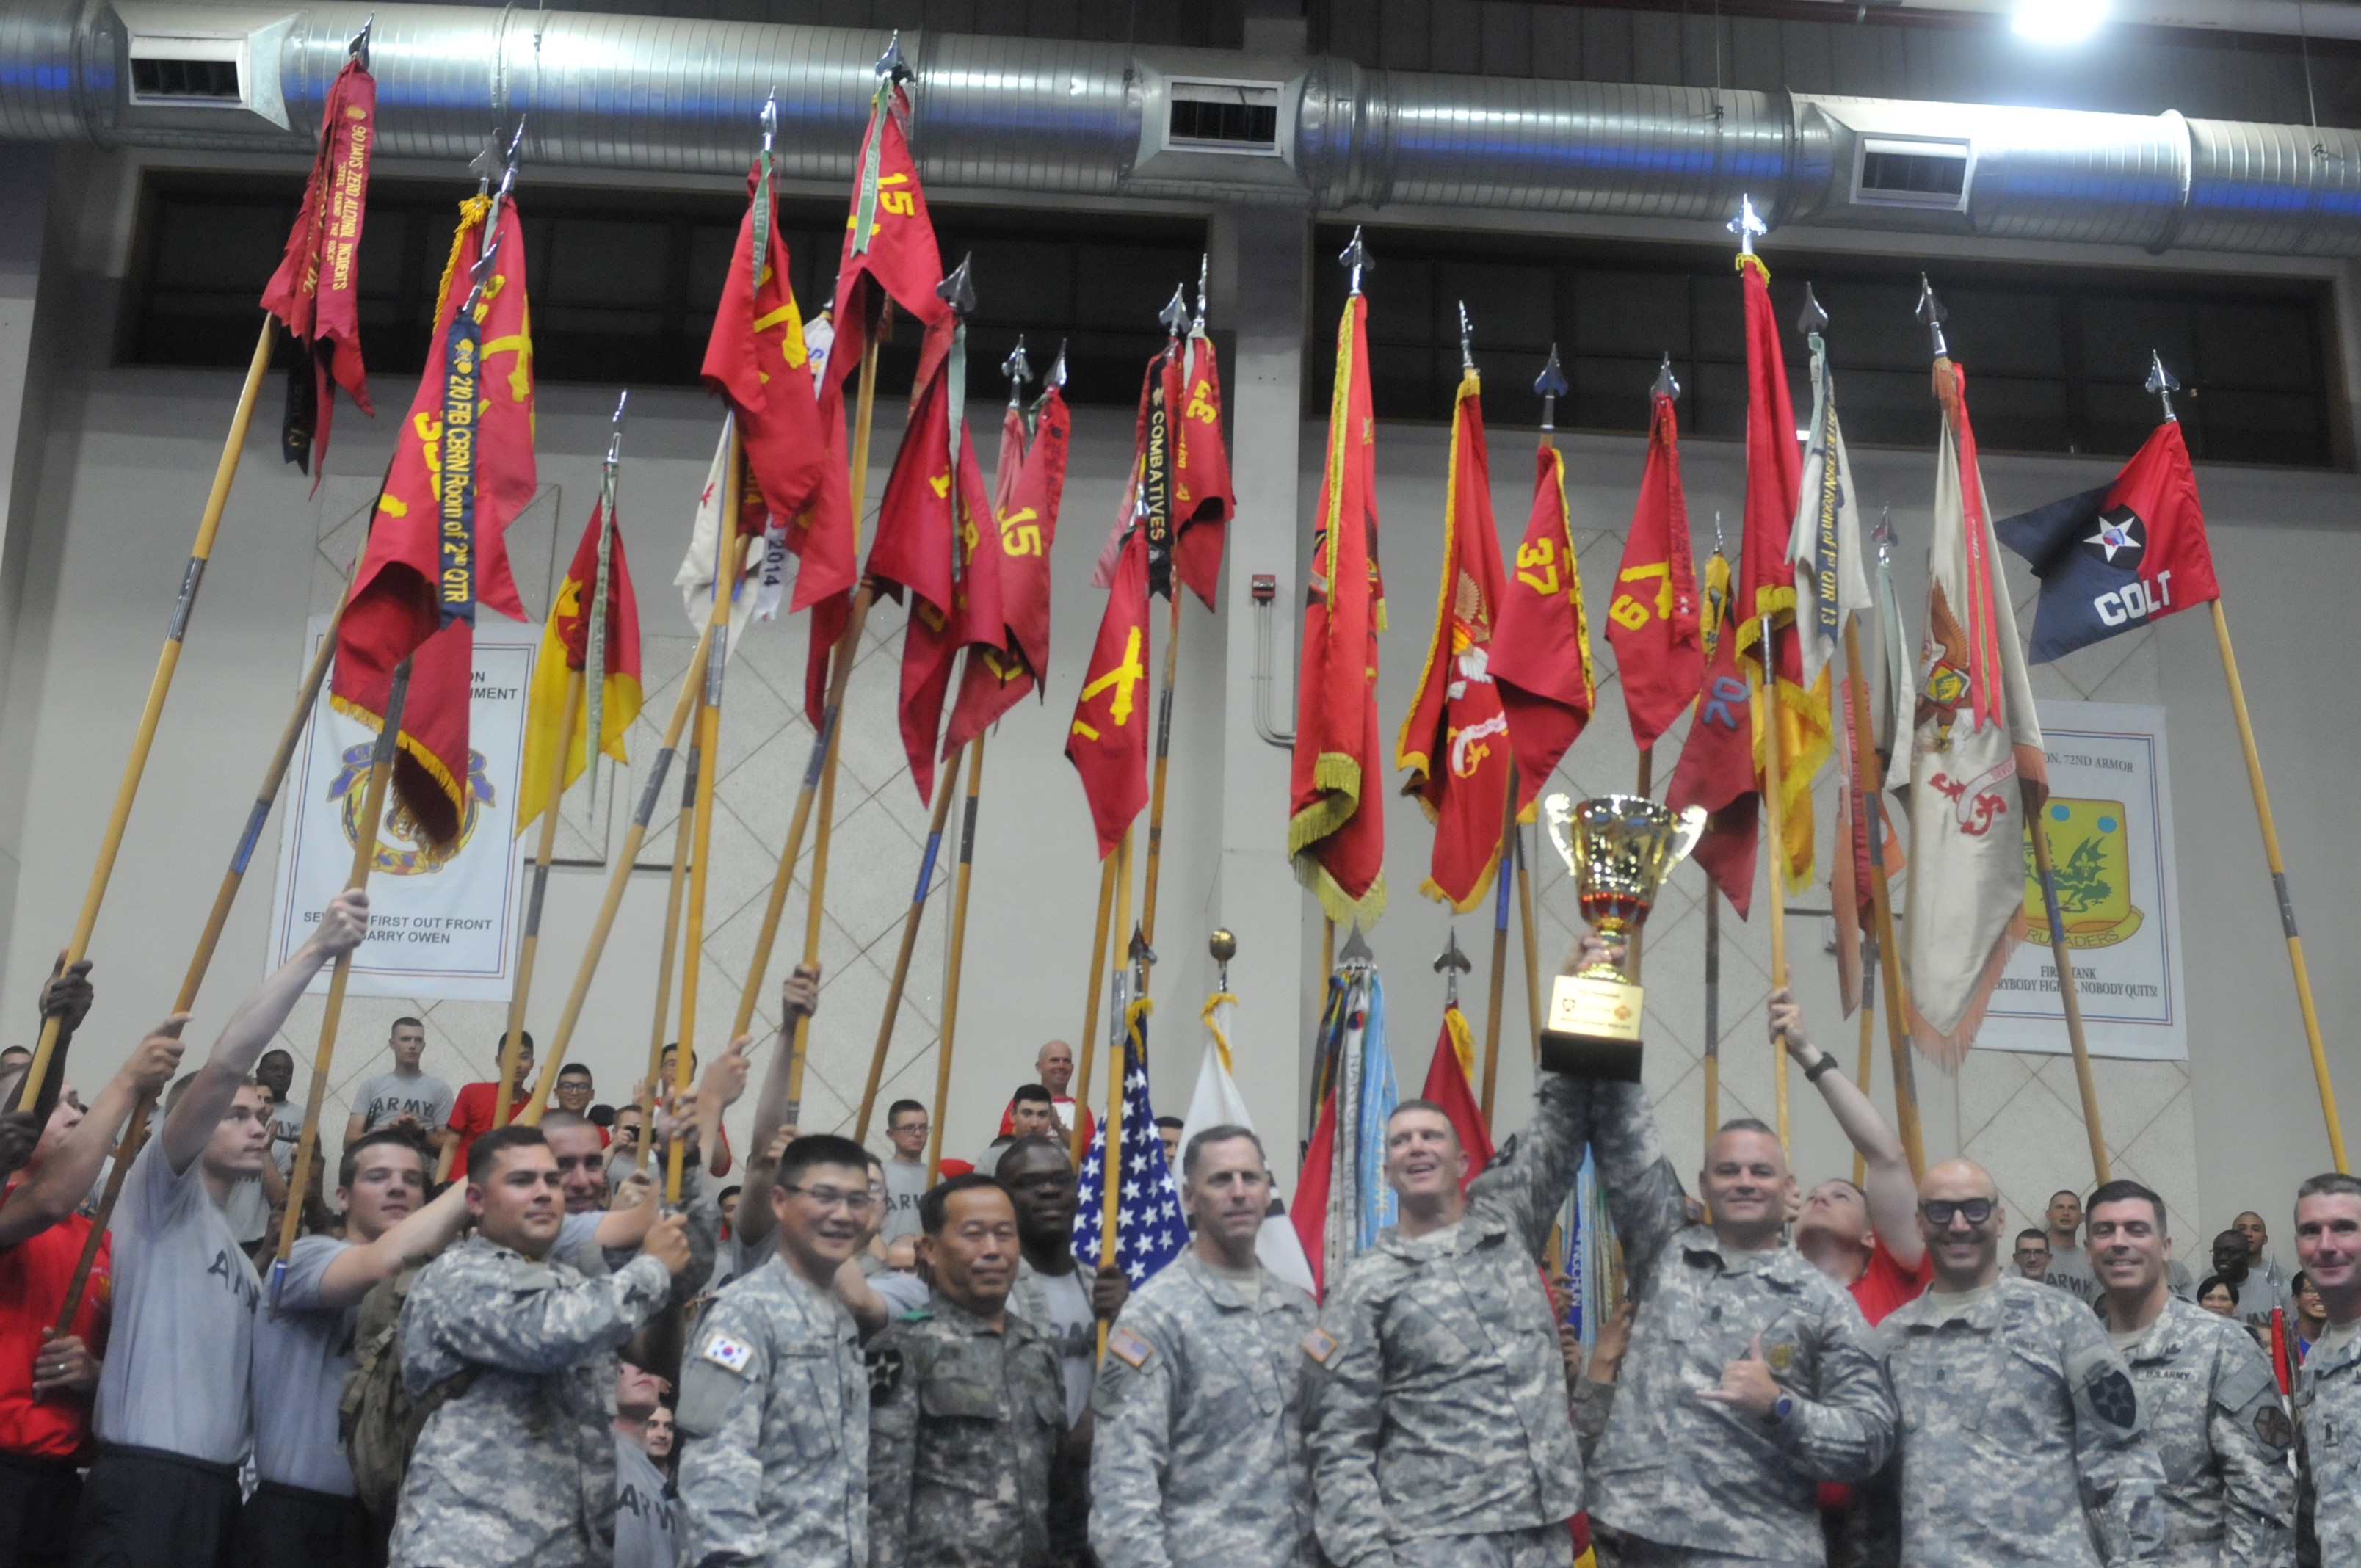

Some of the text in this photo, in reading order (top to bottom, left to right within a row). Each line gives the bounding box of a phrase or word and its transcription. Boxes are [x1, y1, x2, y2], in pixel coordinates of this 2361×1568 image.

[351, 124, 367, 142] 90
[449, 375, 474, 400] 210
[445, 428, 472, 473] CBRN
[1148, 410, 1166, 542] COMBATIVES
[443, 473, 469, 519] Room
[1821, 489, 1837, 529] Room
[443, 521, 468, 540] of
[1822, 530, 1838, 548] of
[763, 539, 785, 587] 2014
[1516, 537, 1559, 595] 37
[443, 568, 469, 603] QTR
[1820, 570, 1836, 601] QTR
[2093, 569, 2171, 627] COLT
[1821, 606, 1837, 626] 13
[2064, 755, 2092, 766] 72ND
[2095, 758, 2133, 773] ARMOR
[370, 915, 493, 930] FIRST OUT FRONT
[407, 932, 451, 944] OWEN
[2027, 929, 2119, 948] RUADERS
[2081, 981, 2125, 995] NOBODY
[2125, 984, 2158, 999] QUITS!
[374, 1097, 434, 1115] ARMY
[2046, 1272, 2091, 1296] ARMY
[2163, 1371, 2191, 1380] ARMY
